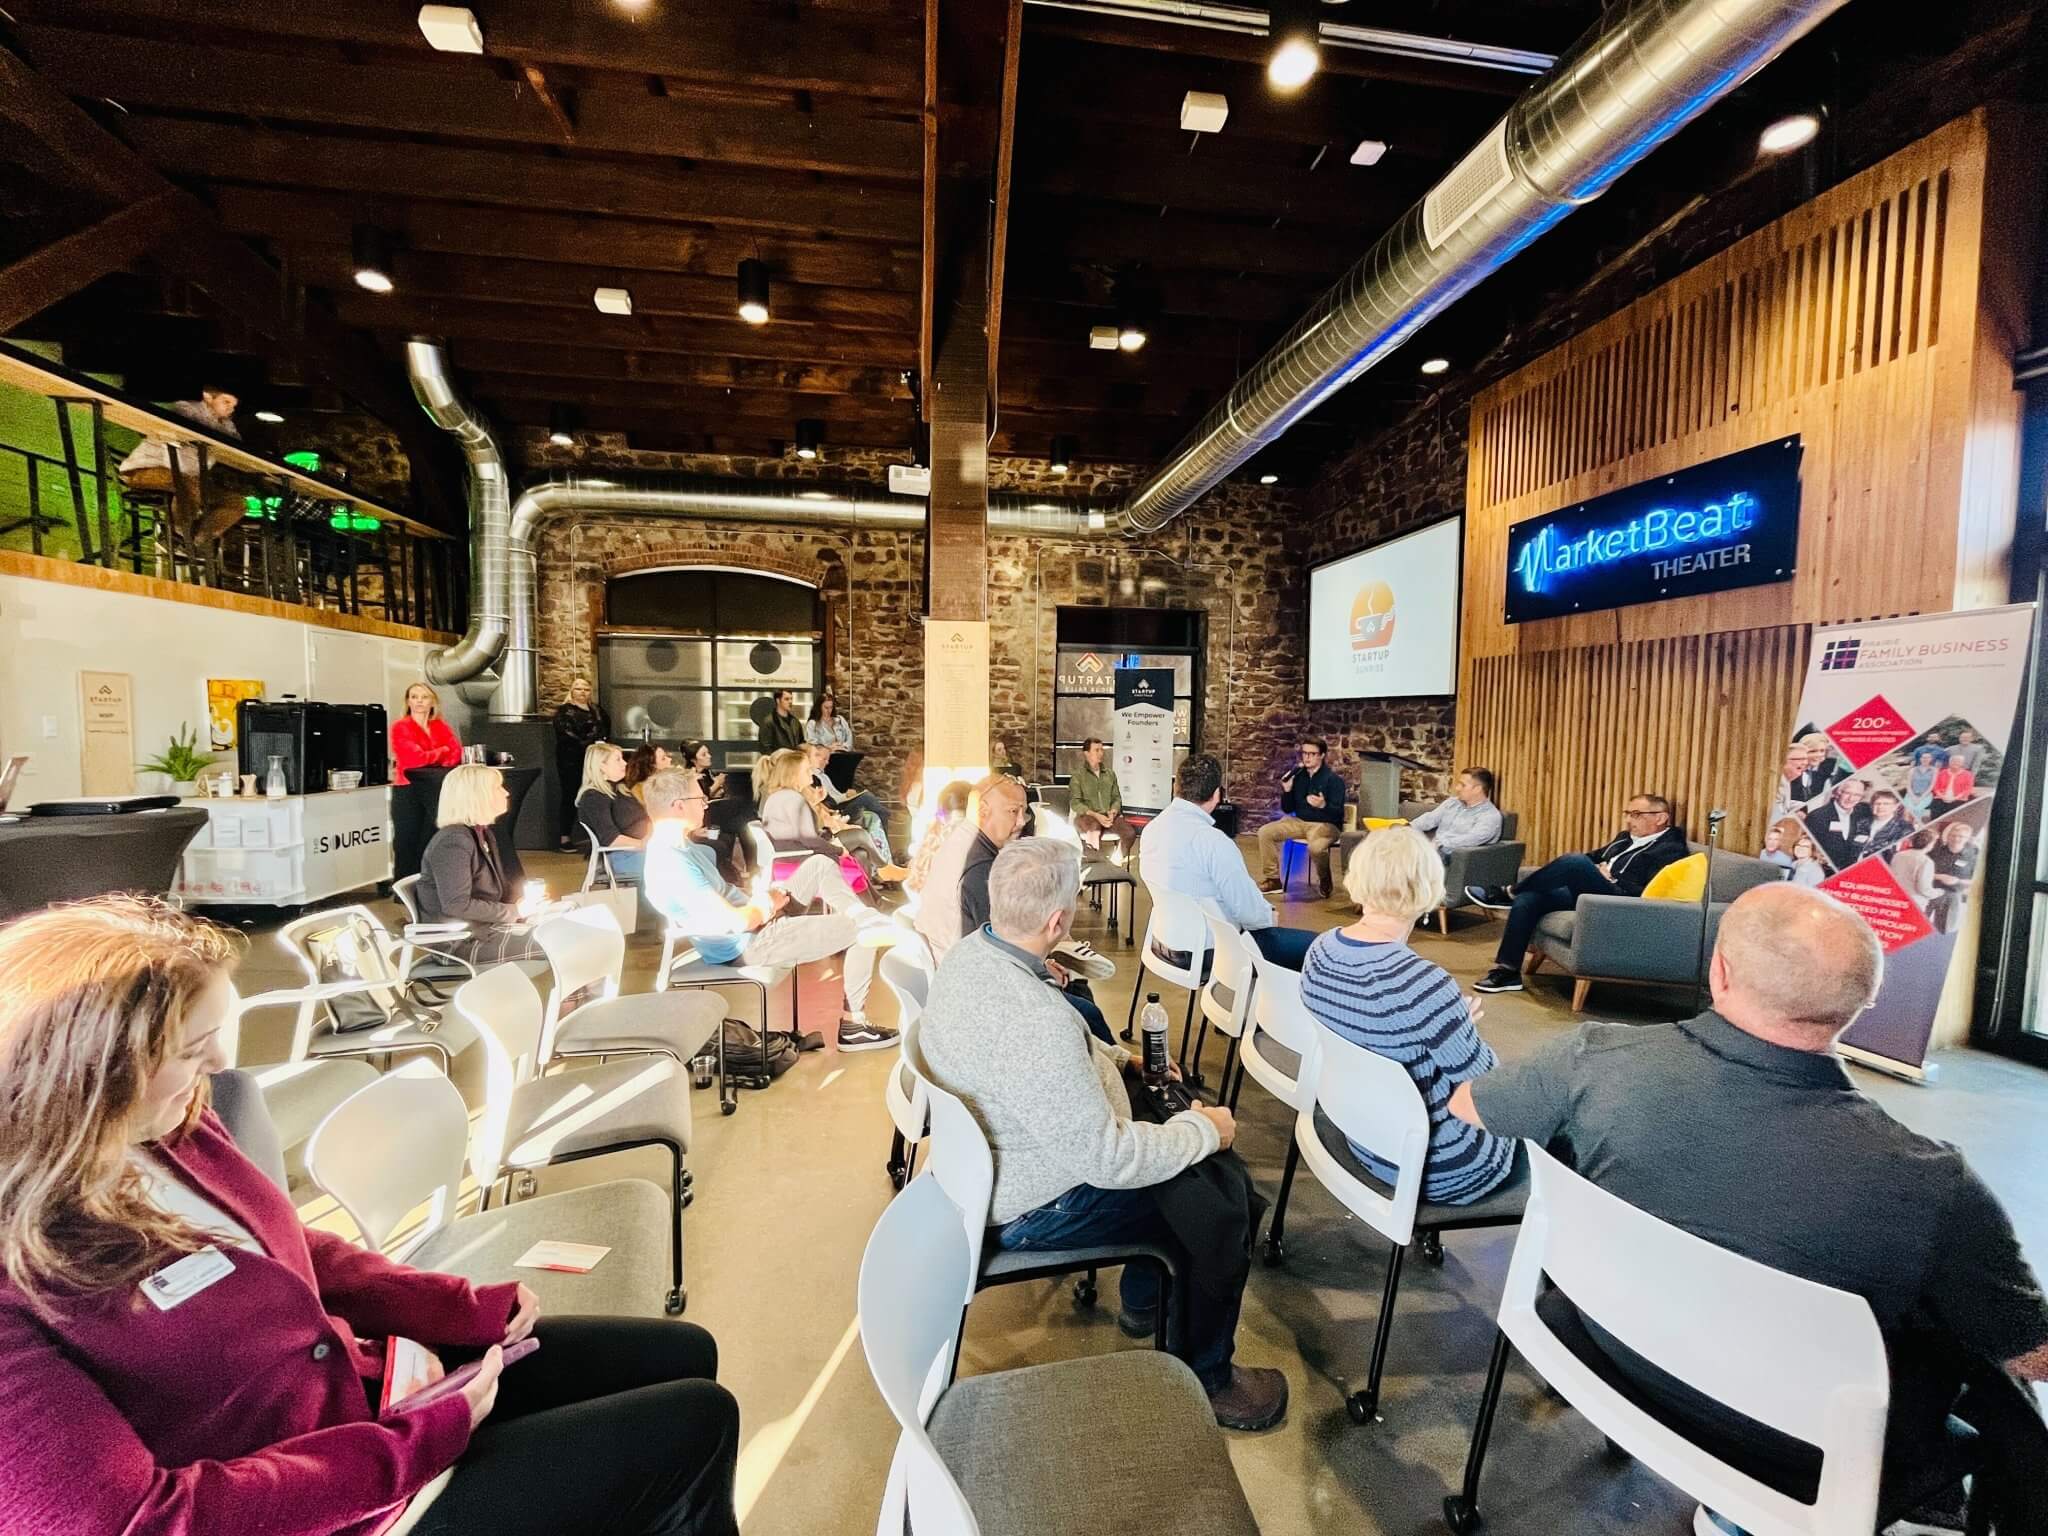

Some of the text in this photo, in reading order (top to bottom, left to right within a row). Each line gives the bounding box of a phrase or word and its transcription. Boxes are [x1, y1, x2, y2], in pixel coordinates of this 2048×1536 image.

[1513, 491, 1755, 592] MarketBeat
[1651, 544, 1751, 580] THEATER
[1352, 649, 1390, 664] STARTUP
[1859, 638, 2009, 660] FAMILY BUSINESS
[1858, 658, 1923, 668] ASSOCIATION
[1852, 717, 1891, 729] 200+
[320, 826, 380, 853] SOURCE
[1839, 881, 1892, 894] EQUIPPING
[1850, 893, 1909, 909] BUSINESSES
[1879, 908, 1901, 918] FOR
